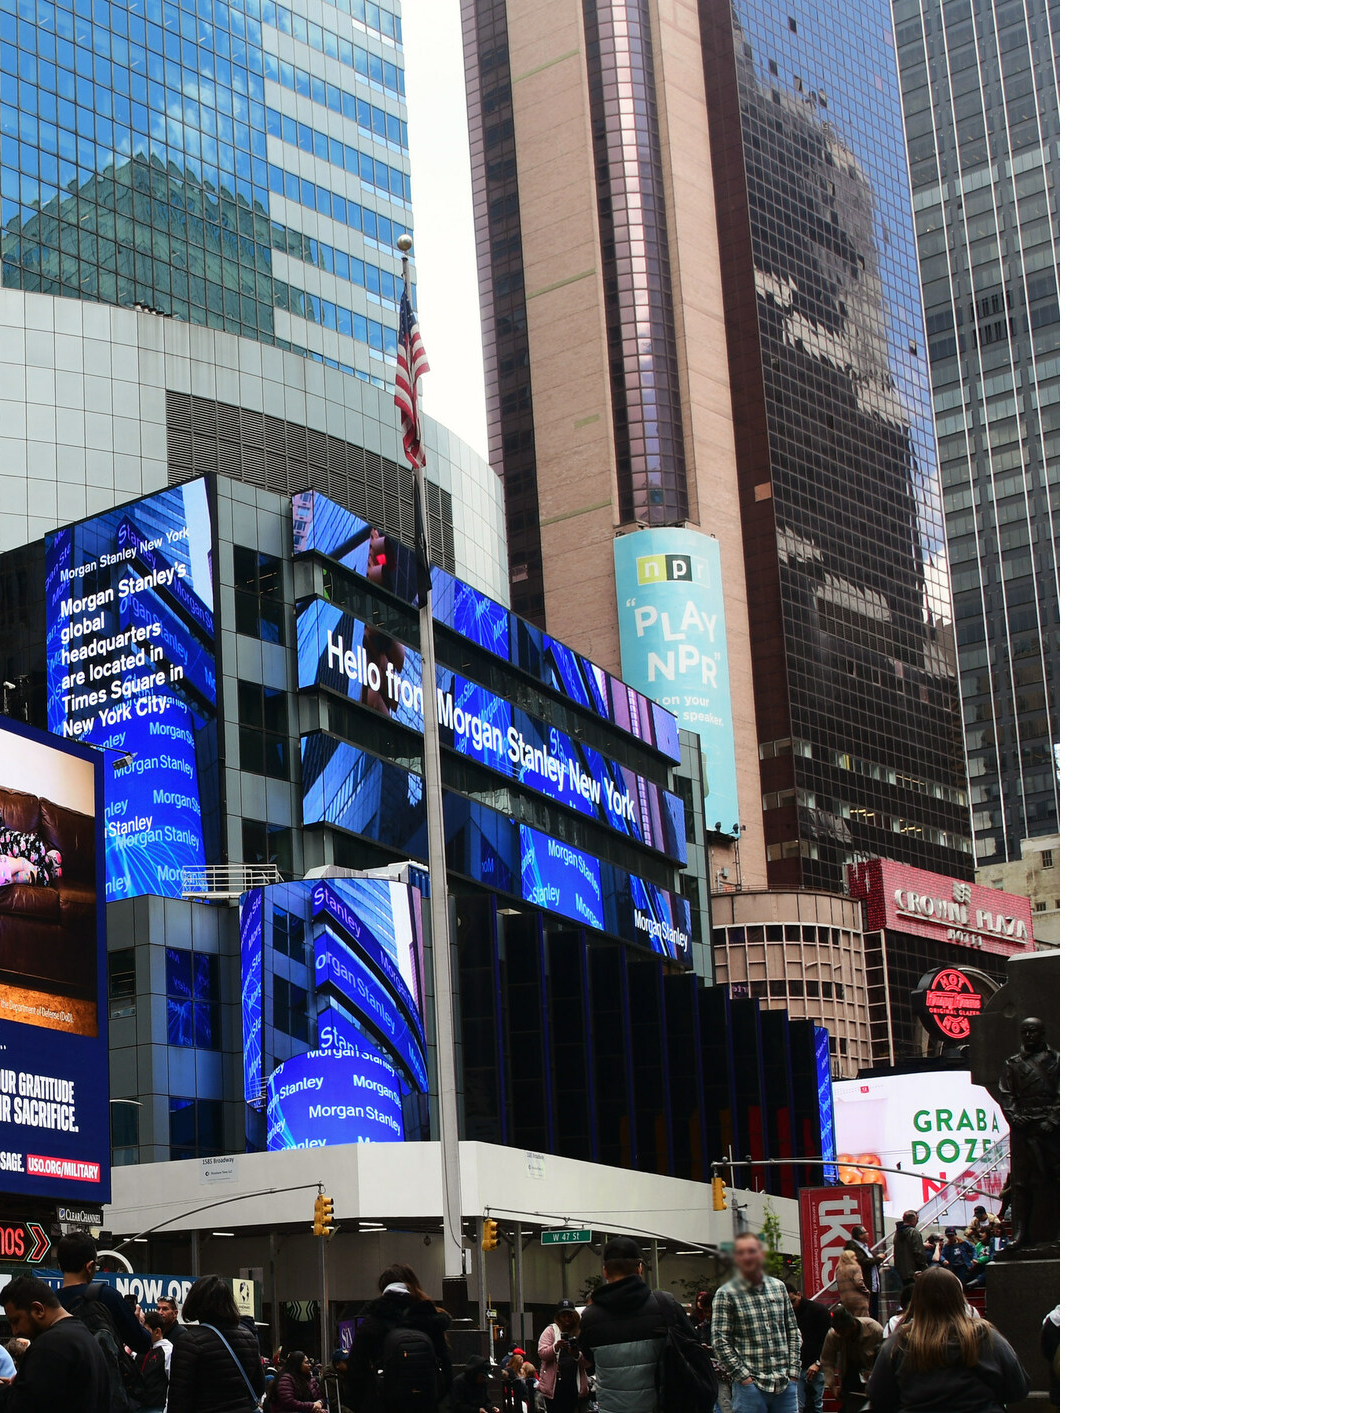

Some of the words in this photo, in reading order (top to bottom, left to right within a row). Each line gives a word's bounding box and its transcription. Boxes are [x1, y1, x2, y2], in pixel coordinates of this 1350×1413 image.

[60, 560, 97, 582] Morgan
[99, 546, 137, 568] Stanley
[140, 536, 163, 554] New
[165, 526, 190, 544] York
[60, 588, 114, 618] Morgan
[118, 561, 187, 598] Stanley's
[60, 612, 105, 645] global
[61, 622, 162, 665] headquarters
[61, 674, 86, 690] are
[89, 647, 145, 682] located
[150, 645, 163, 660] in
[61, 688, 107, 713] Times
[111, 671, 166, 700] Square
[169, 663, 184, 682] in
[662, 695, 681, 705] on
[683, 695, 710, 708] your
[62, 717, 95, 738] New
[98, 702, 133, 727] York
[136, 693, 170, 717] City.
[326, 629, 381, 692] Hello
[436, 687, 504, 756] Morgan
[506, 726, 565, 793] Stanley
[568, 758, 601, 805] New
[604, 777, 637, 823] York
[109, 815, 153, 837] Stanley
[548, 839, 578, 868] Morgan
[532, 882, 560, 906] Stanley
[313, 886, 362, 939] Stanley
[976, 908, 1028, 940] PLAZA
[634, 908, 662, 939] Morgan
[661, 920, 688, 953] Stanley
[940, 974, 965, 989] HOT
[942, 1015, 971, 1034] NOW
[18, 1072, 75, 1105] GRATITUDE
[279, 1076, 324, 1100] Stanley
[353, 1073, 393, 1100] Morgan
[14, 1096, 79, 1133] SACRIFICE.
[308, 1105, 364, 1120] Morgan
[366, 1106, 401, 1137] Stanley
[913, 1108, 988, 1133] GRAB
[992, 1109, 1000, 1133] A
[28, 1156, 99, 1180] USO.ORG/MILITARY
[553, 1233, 559, 1241] W
[562, 1232, 570, 1240] 47
[572, 1232, 579, 1240] St
[116, 1278, 163, 1304] NOW
